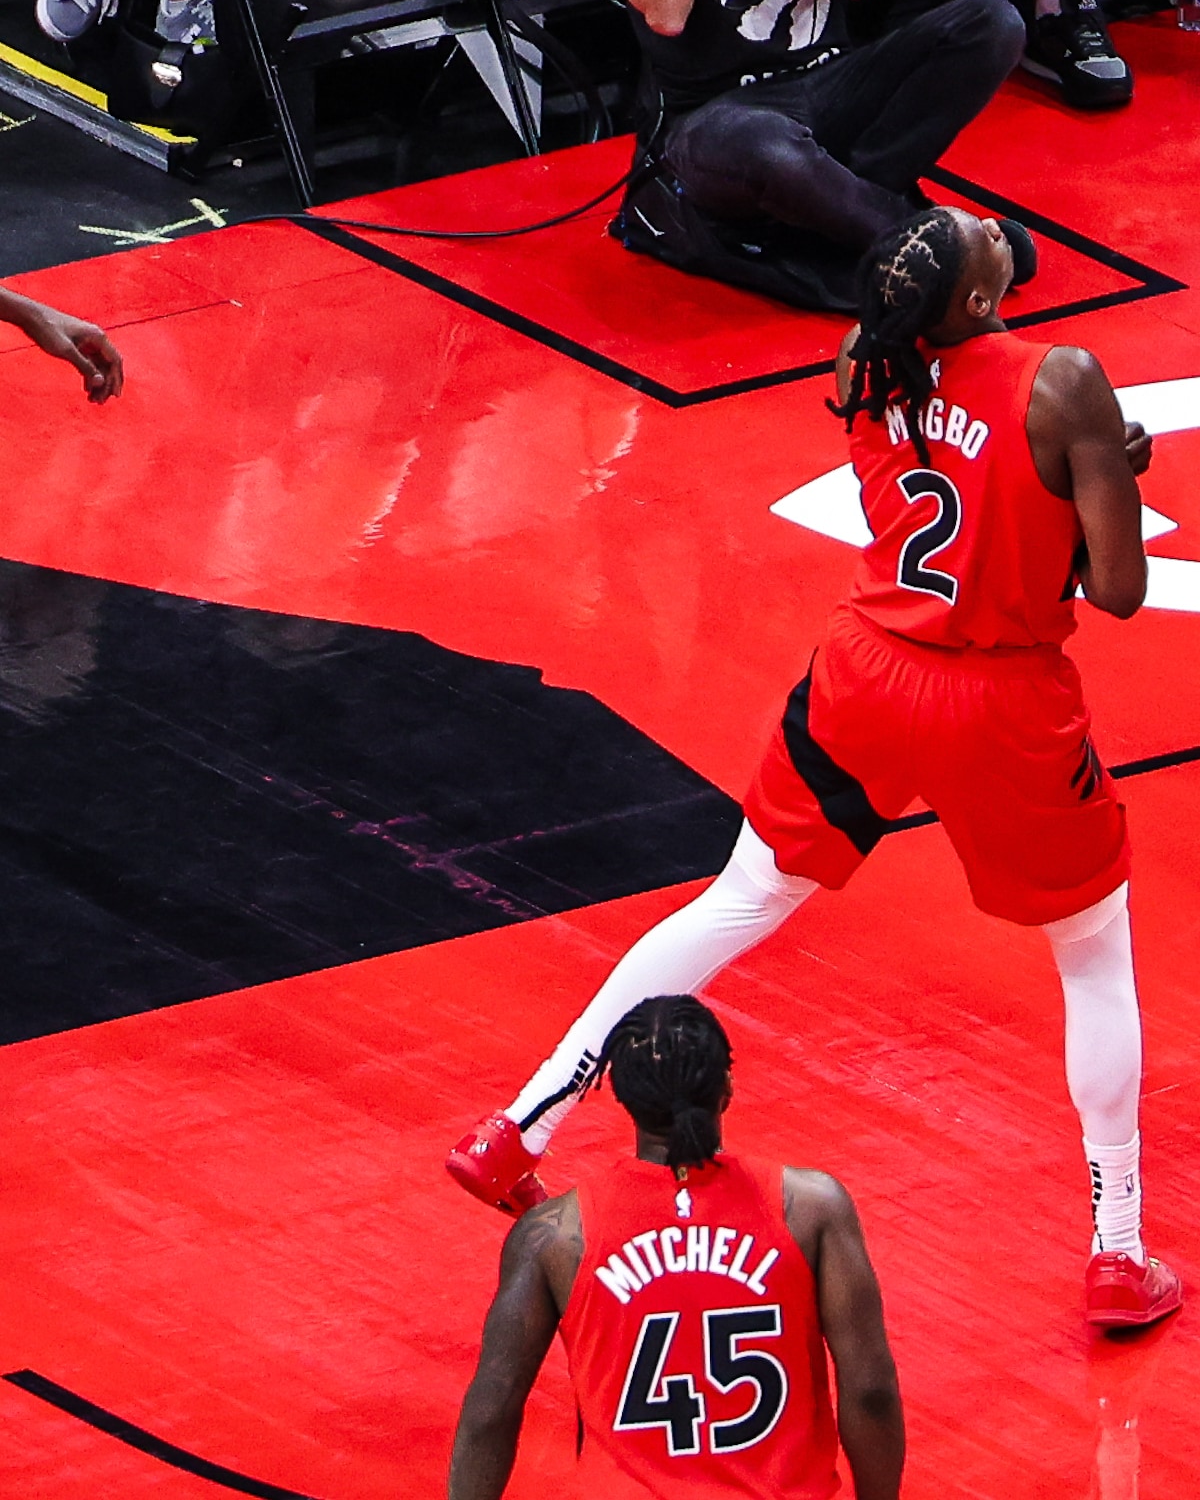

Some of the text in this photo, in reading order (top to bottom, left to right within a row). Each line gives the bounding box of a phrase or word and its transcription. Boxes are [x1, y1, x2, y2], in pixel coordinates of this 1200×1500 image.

[896, 467, 962, 606] 2
[595, 1225, 780, 1305] MITCHELL
[613, 1304, 788, 1457] 45
